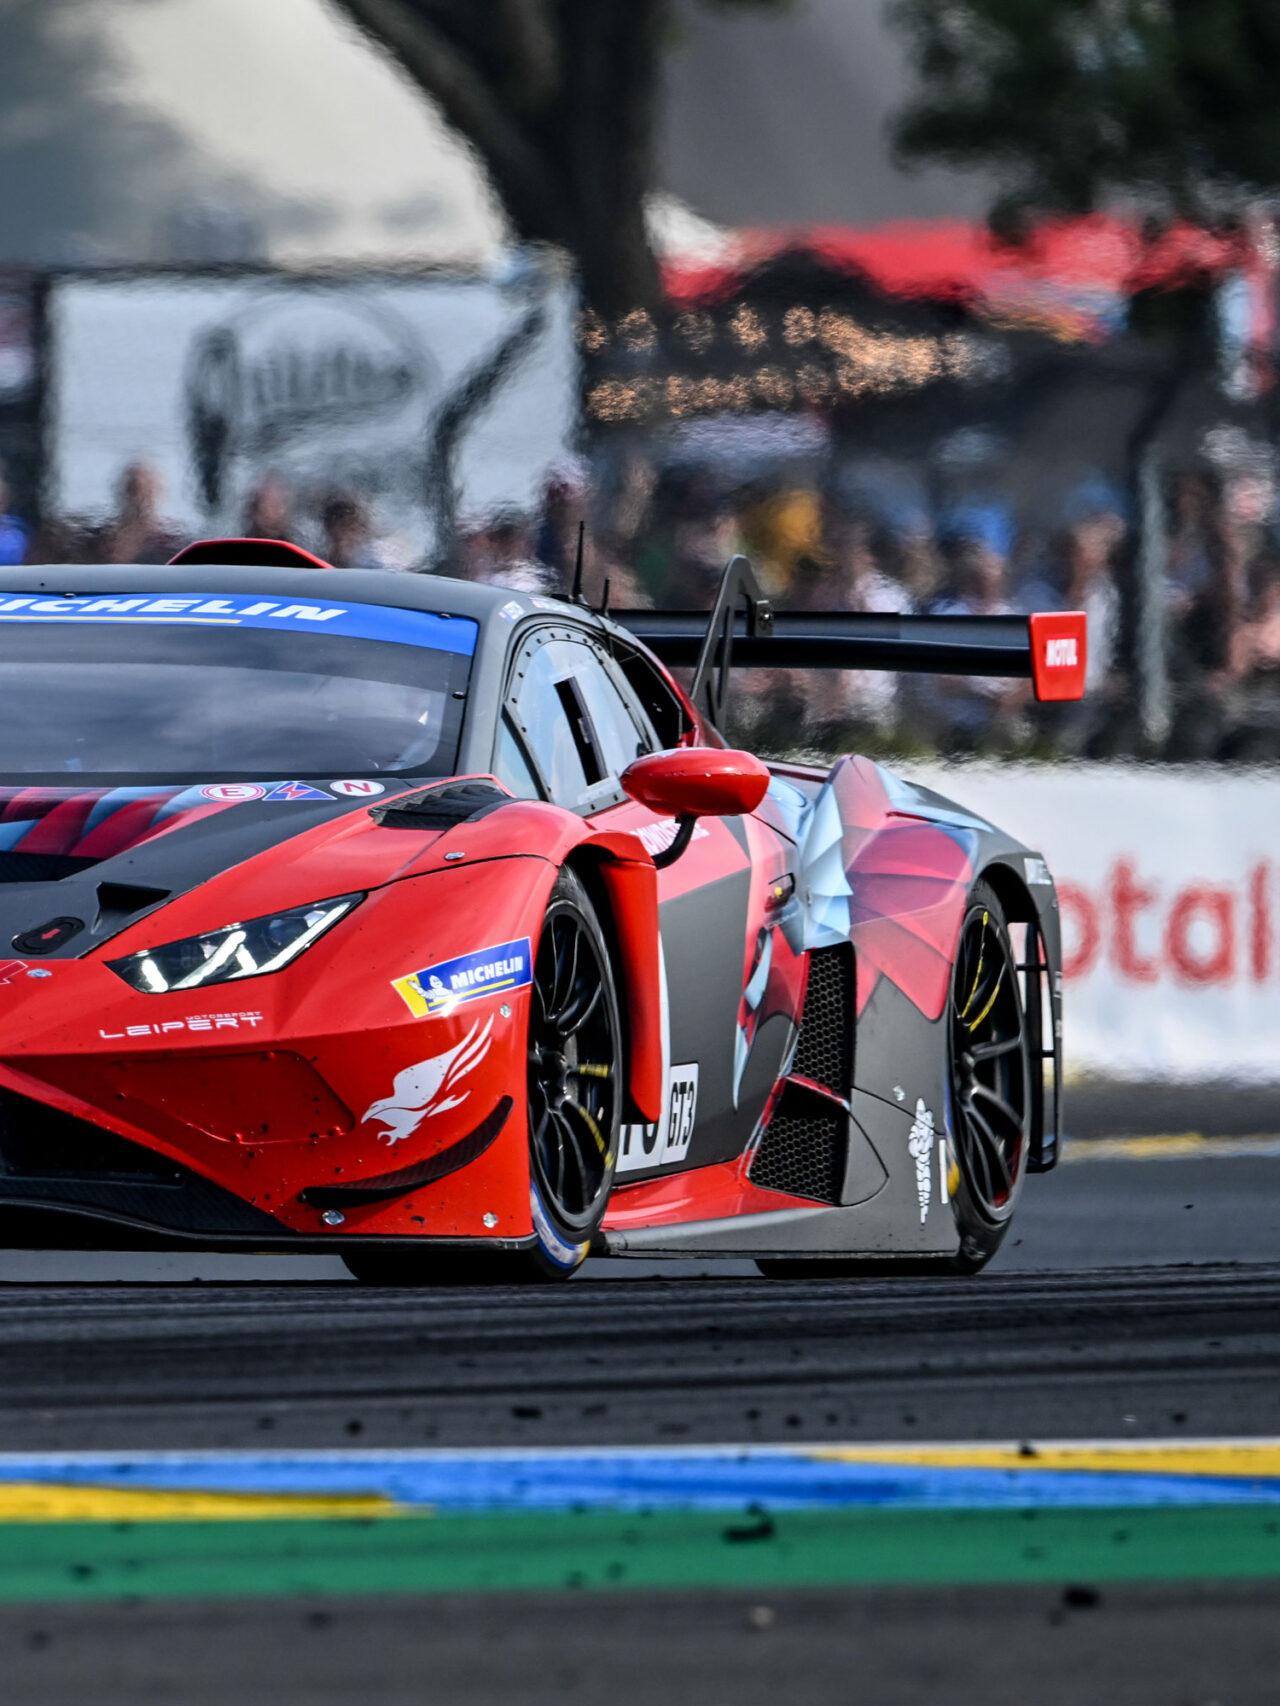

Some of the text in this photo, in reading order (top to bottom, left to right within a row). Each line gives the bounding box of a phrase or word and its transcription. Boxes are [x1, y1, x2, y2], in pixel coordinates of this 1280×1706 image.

[449, 955, 524, 990] MICHELIN
[99, 1016, 264, 1039] LEIPERT
[666, 1081, 695, 1148] GT3
